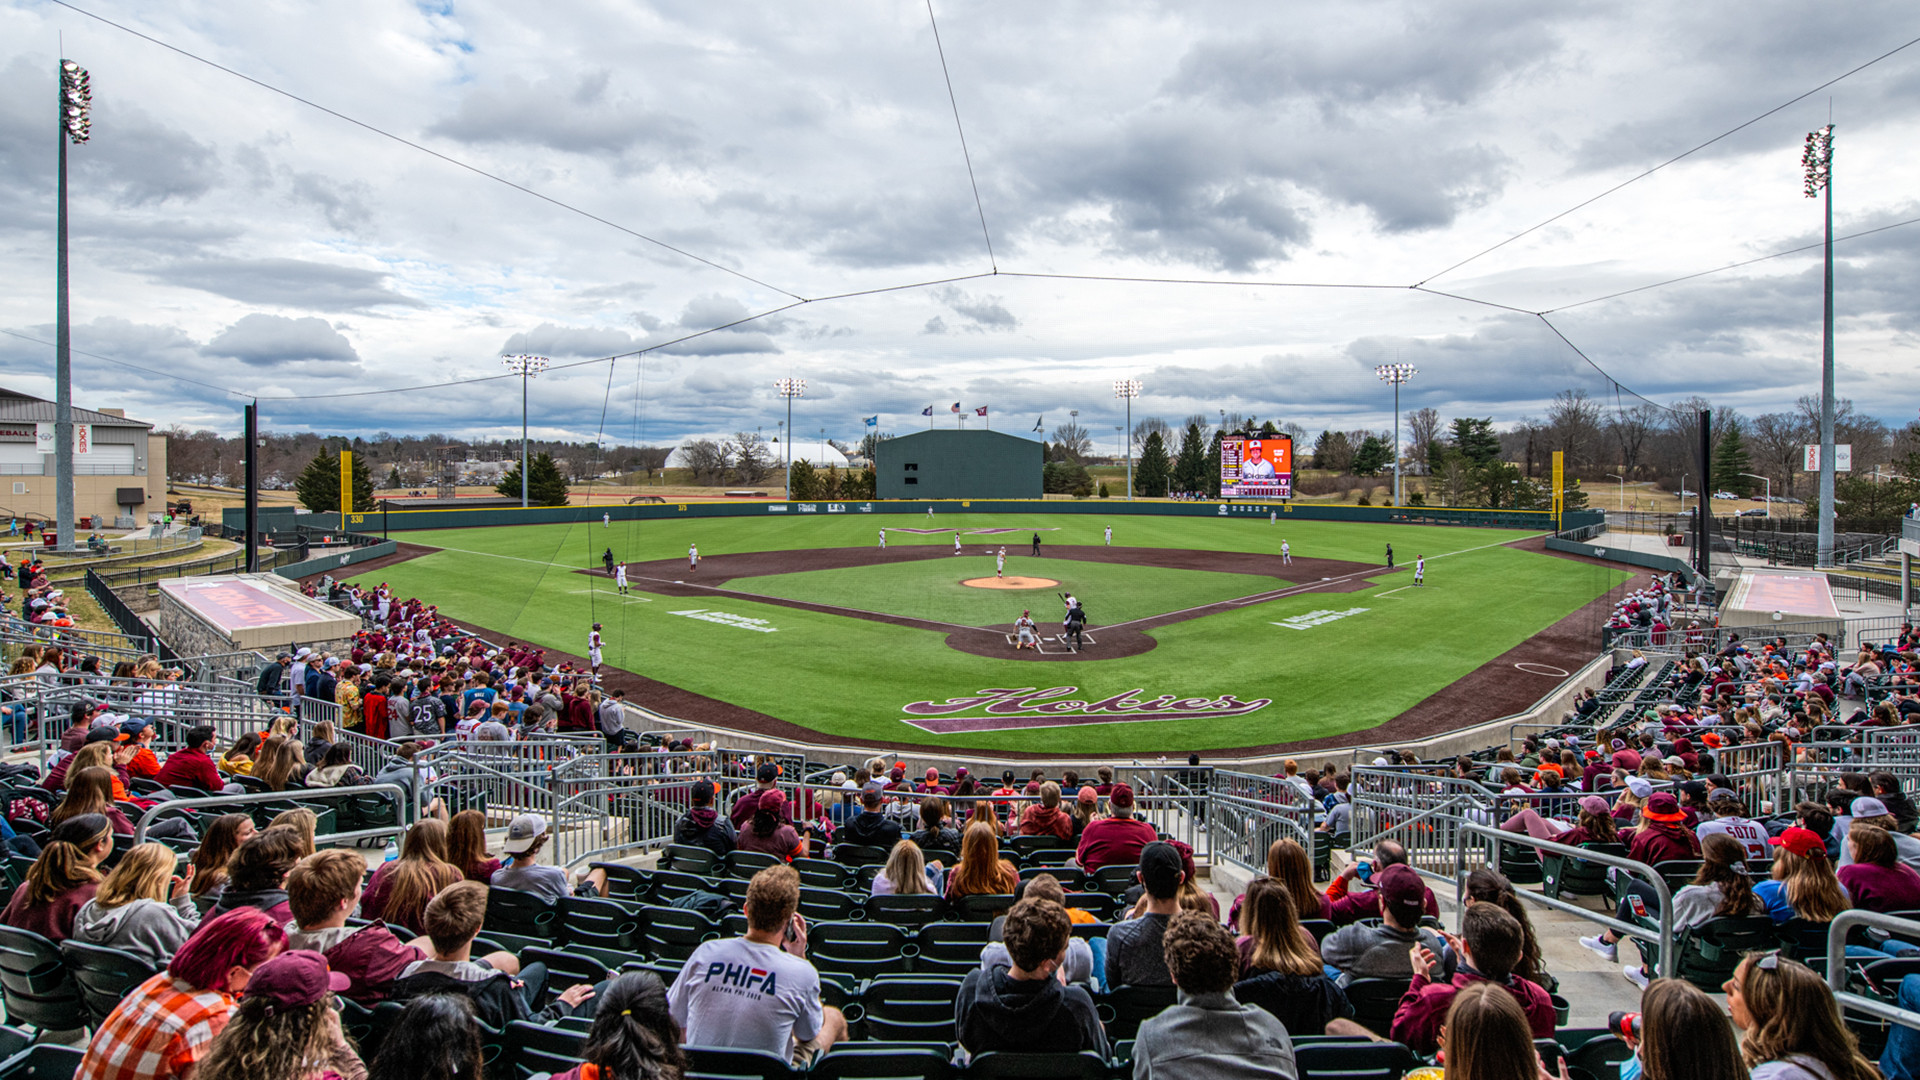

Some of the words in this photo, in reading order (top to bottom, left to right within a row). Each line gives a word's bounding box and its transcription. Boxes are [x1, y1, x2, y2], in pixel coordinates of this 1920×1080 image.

[1249, 430, 1262, 438] VT
[350, 514, 364, 524] 330
[902, 687, 1271, 716] Hokies
[413, 704, 432, 724] 25
[1725, 826, 1757, 840] SOTO
[704, 962, 776, 996] PHIFA
